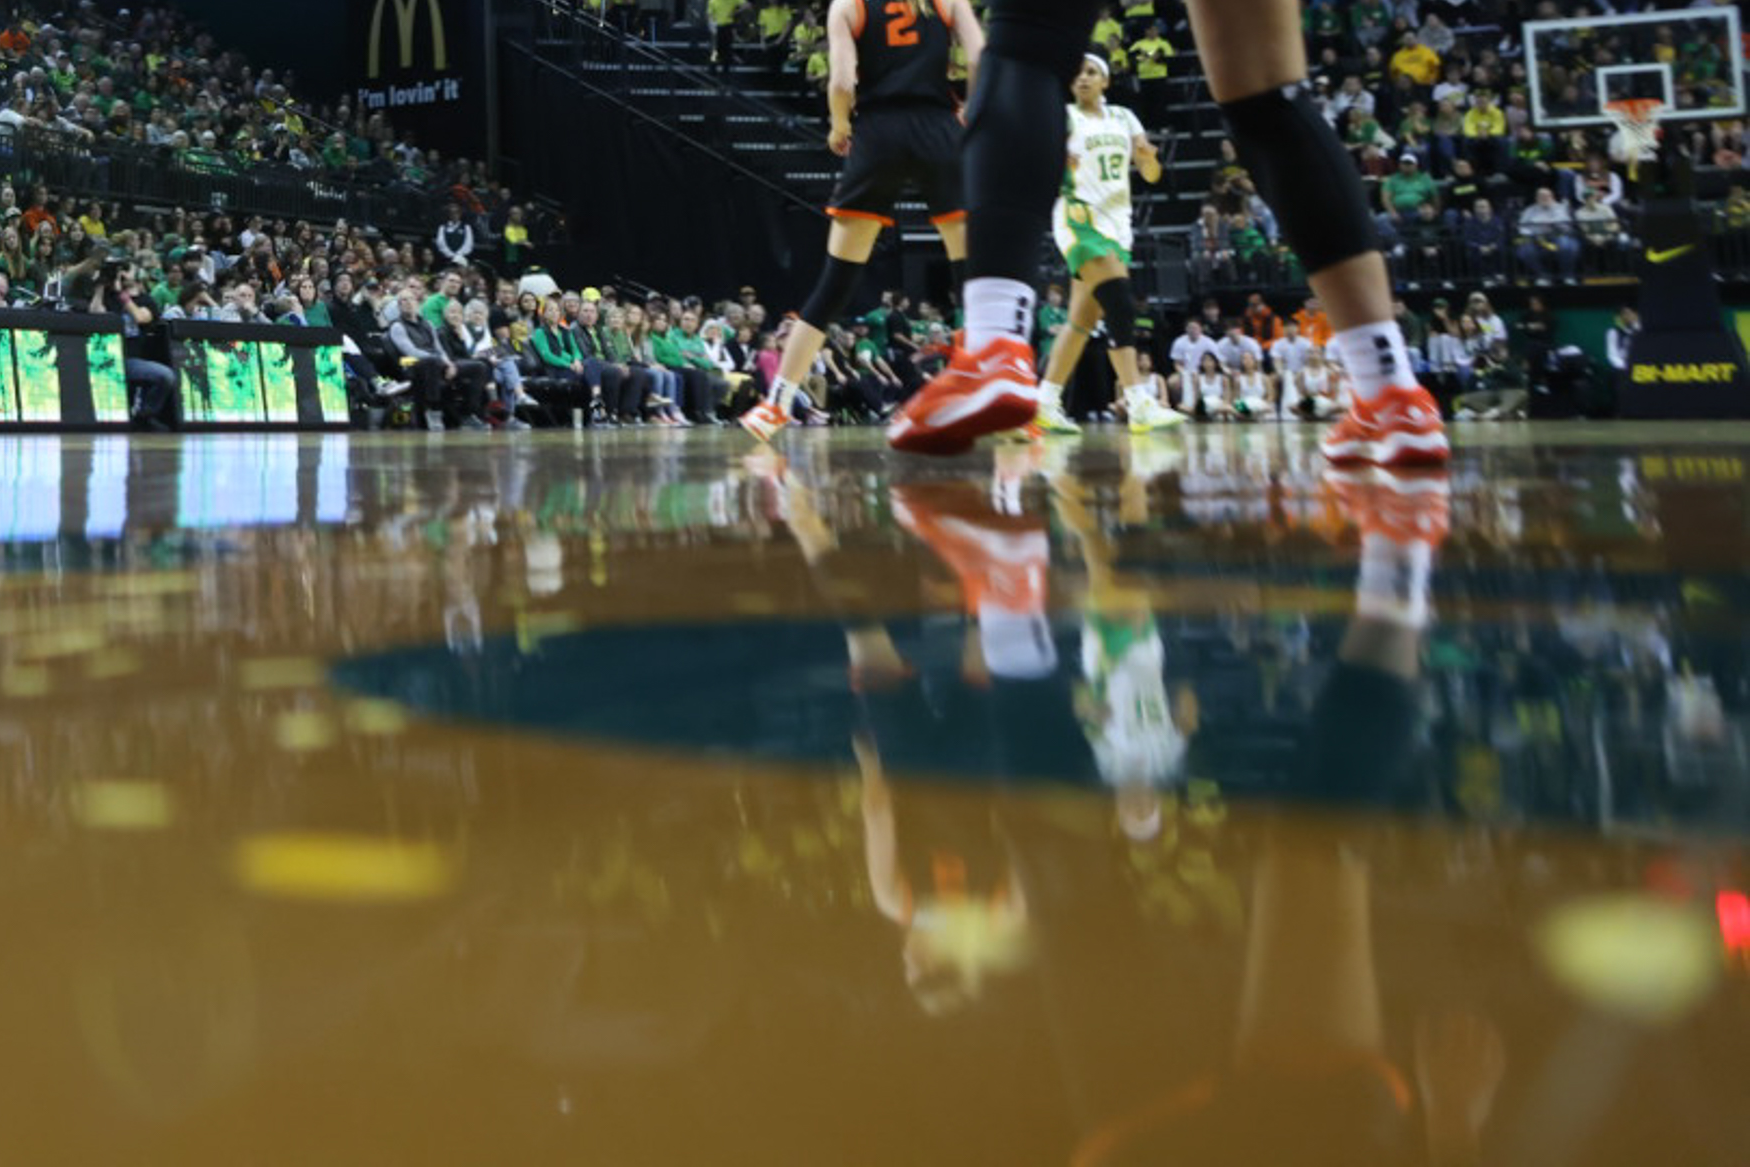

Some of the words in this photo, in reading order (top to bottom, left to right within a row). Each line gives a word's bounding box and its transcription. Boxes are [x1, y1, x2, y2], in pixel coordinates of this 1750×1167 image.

[885, 1, 920, 47] 2
[389, 80, 441, 106] lovin'
[444, 77, 459, 101] it
[1632, 362, 1737, 384] BI-MART
